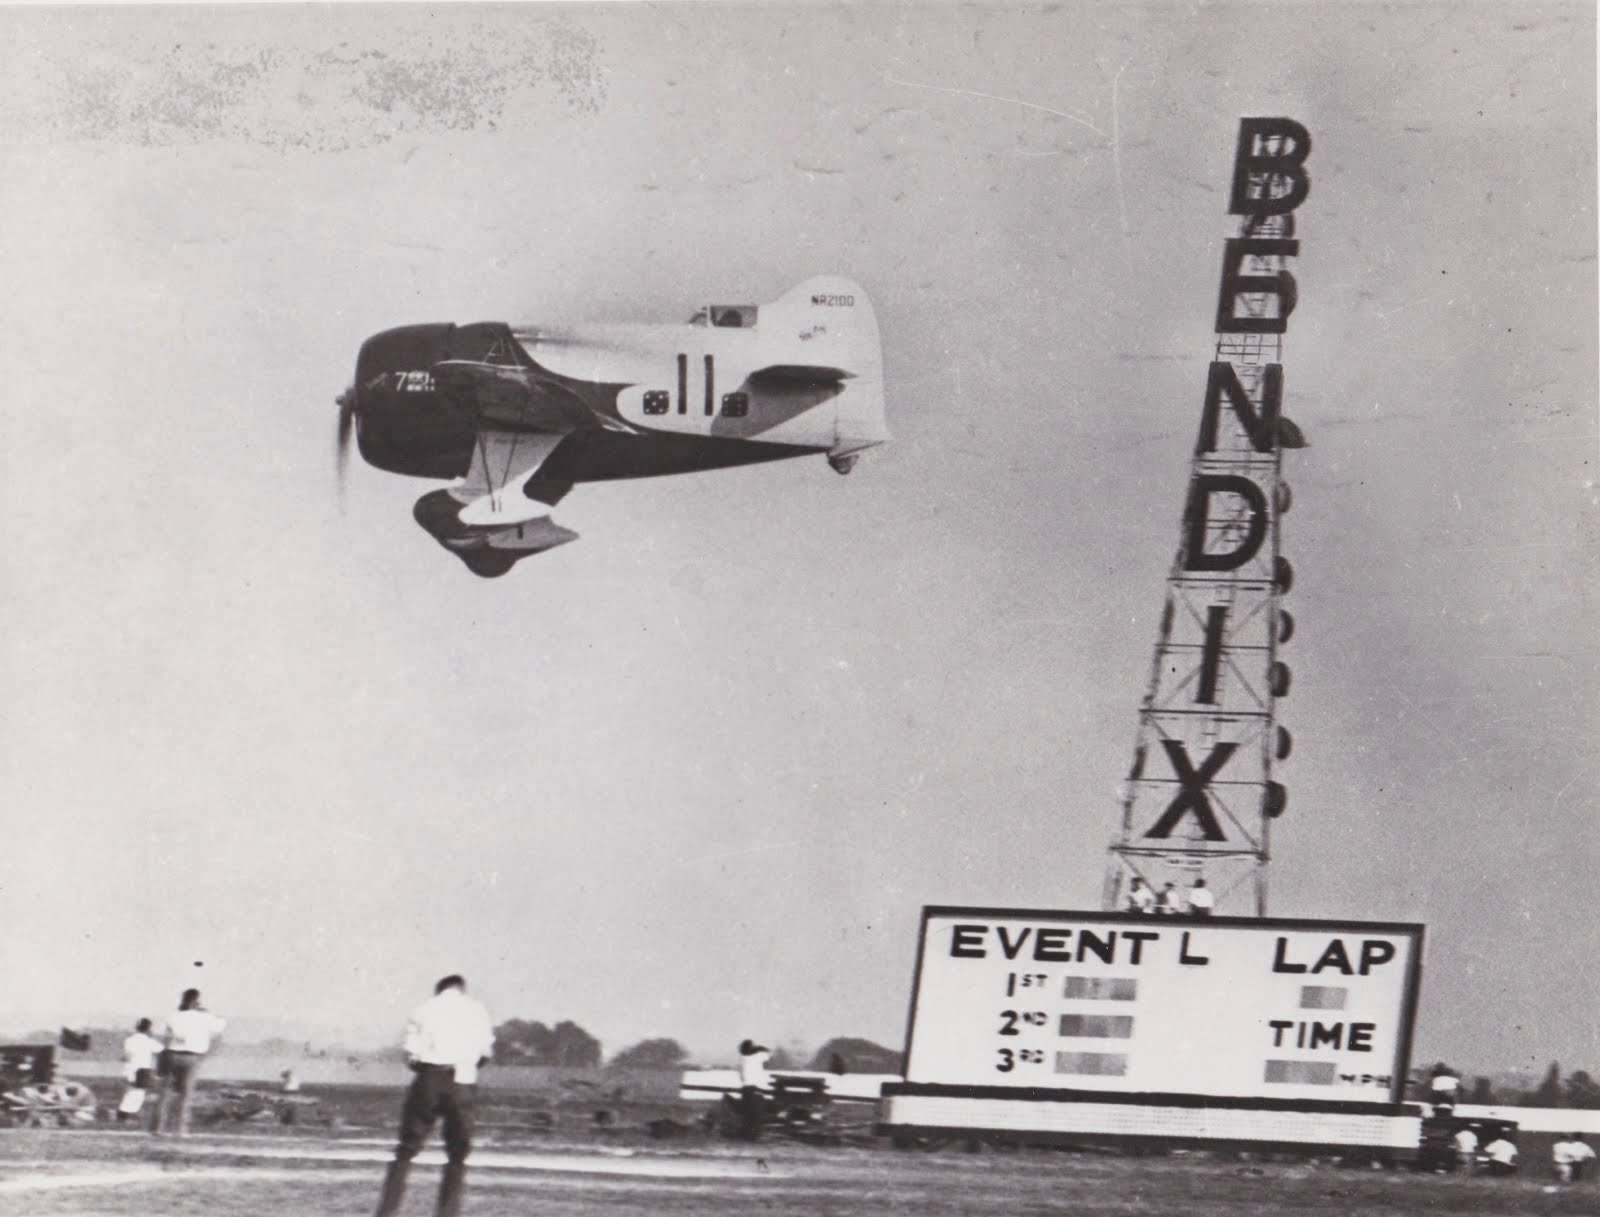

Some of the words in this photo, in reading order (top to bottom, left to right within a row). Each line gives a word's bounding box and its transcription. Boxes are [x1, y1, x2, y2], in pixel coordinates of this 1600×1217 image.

[811, 294, 855, 307] NR2100
[1142, 117, 1312, 841] BENDIX
[950, 924, 1160, 966] EVENT
[1272, 936, 1397, 976] LAP
[1269, 1020, 1377, 1052] TIME
